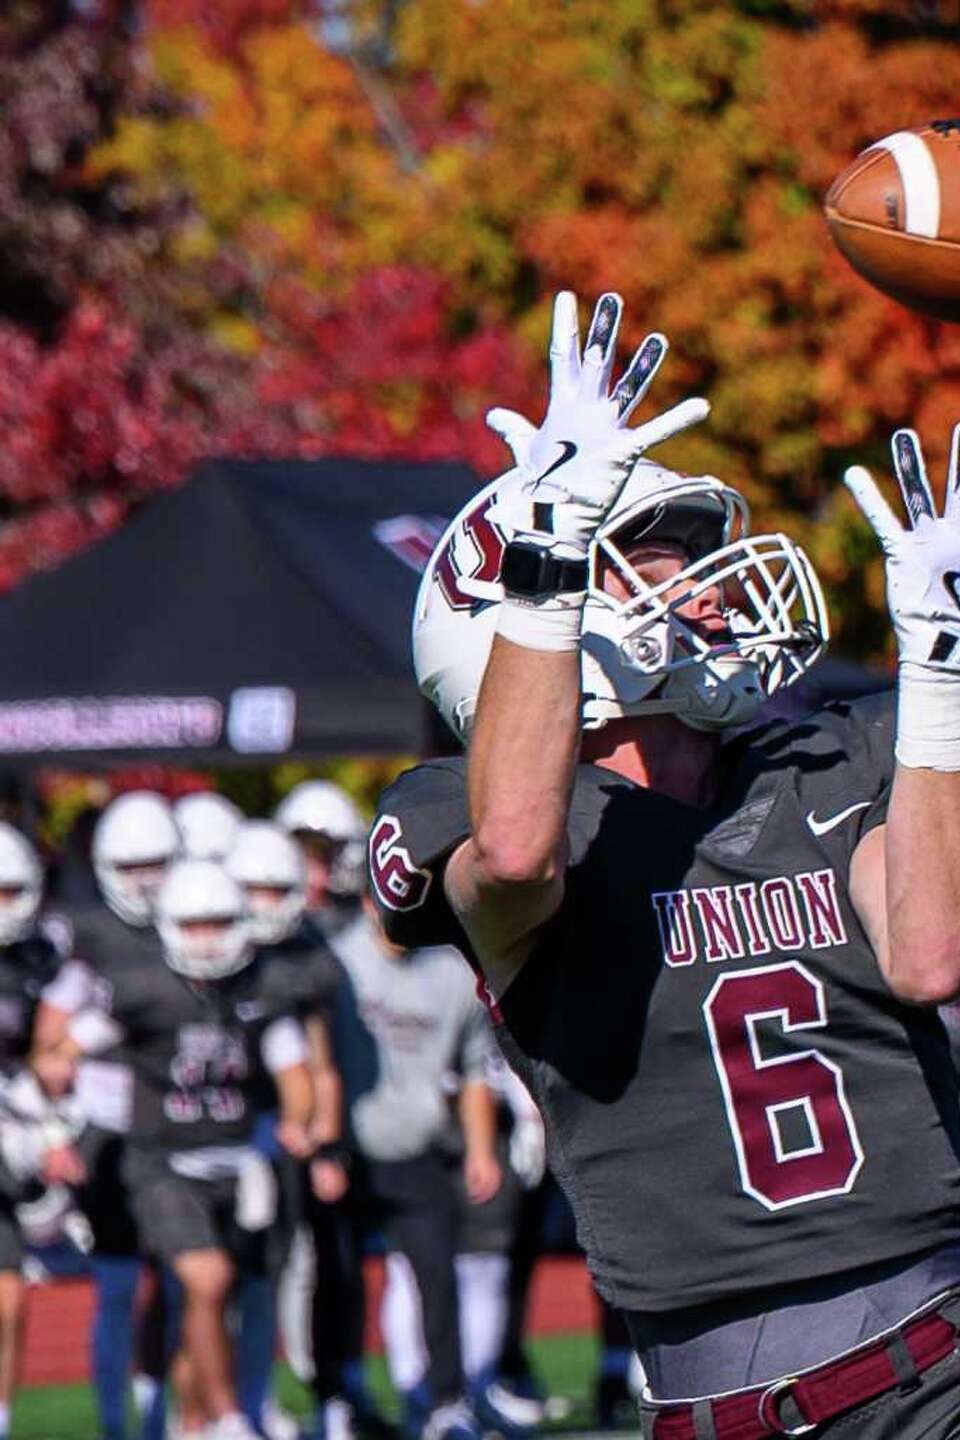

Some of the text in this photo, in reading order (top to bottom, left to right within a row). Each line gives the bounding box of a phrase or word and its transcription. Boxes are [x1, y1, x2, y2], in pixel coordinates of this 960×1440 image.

[369, 814, 430, 912] 6
[652, 868, 847, 968] UNION
[702, 960, 864, 1211] 6
